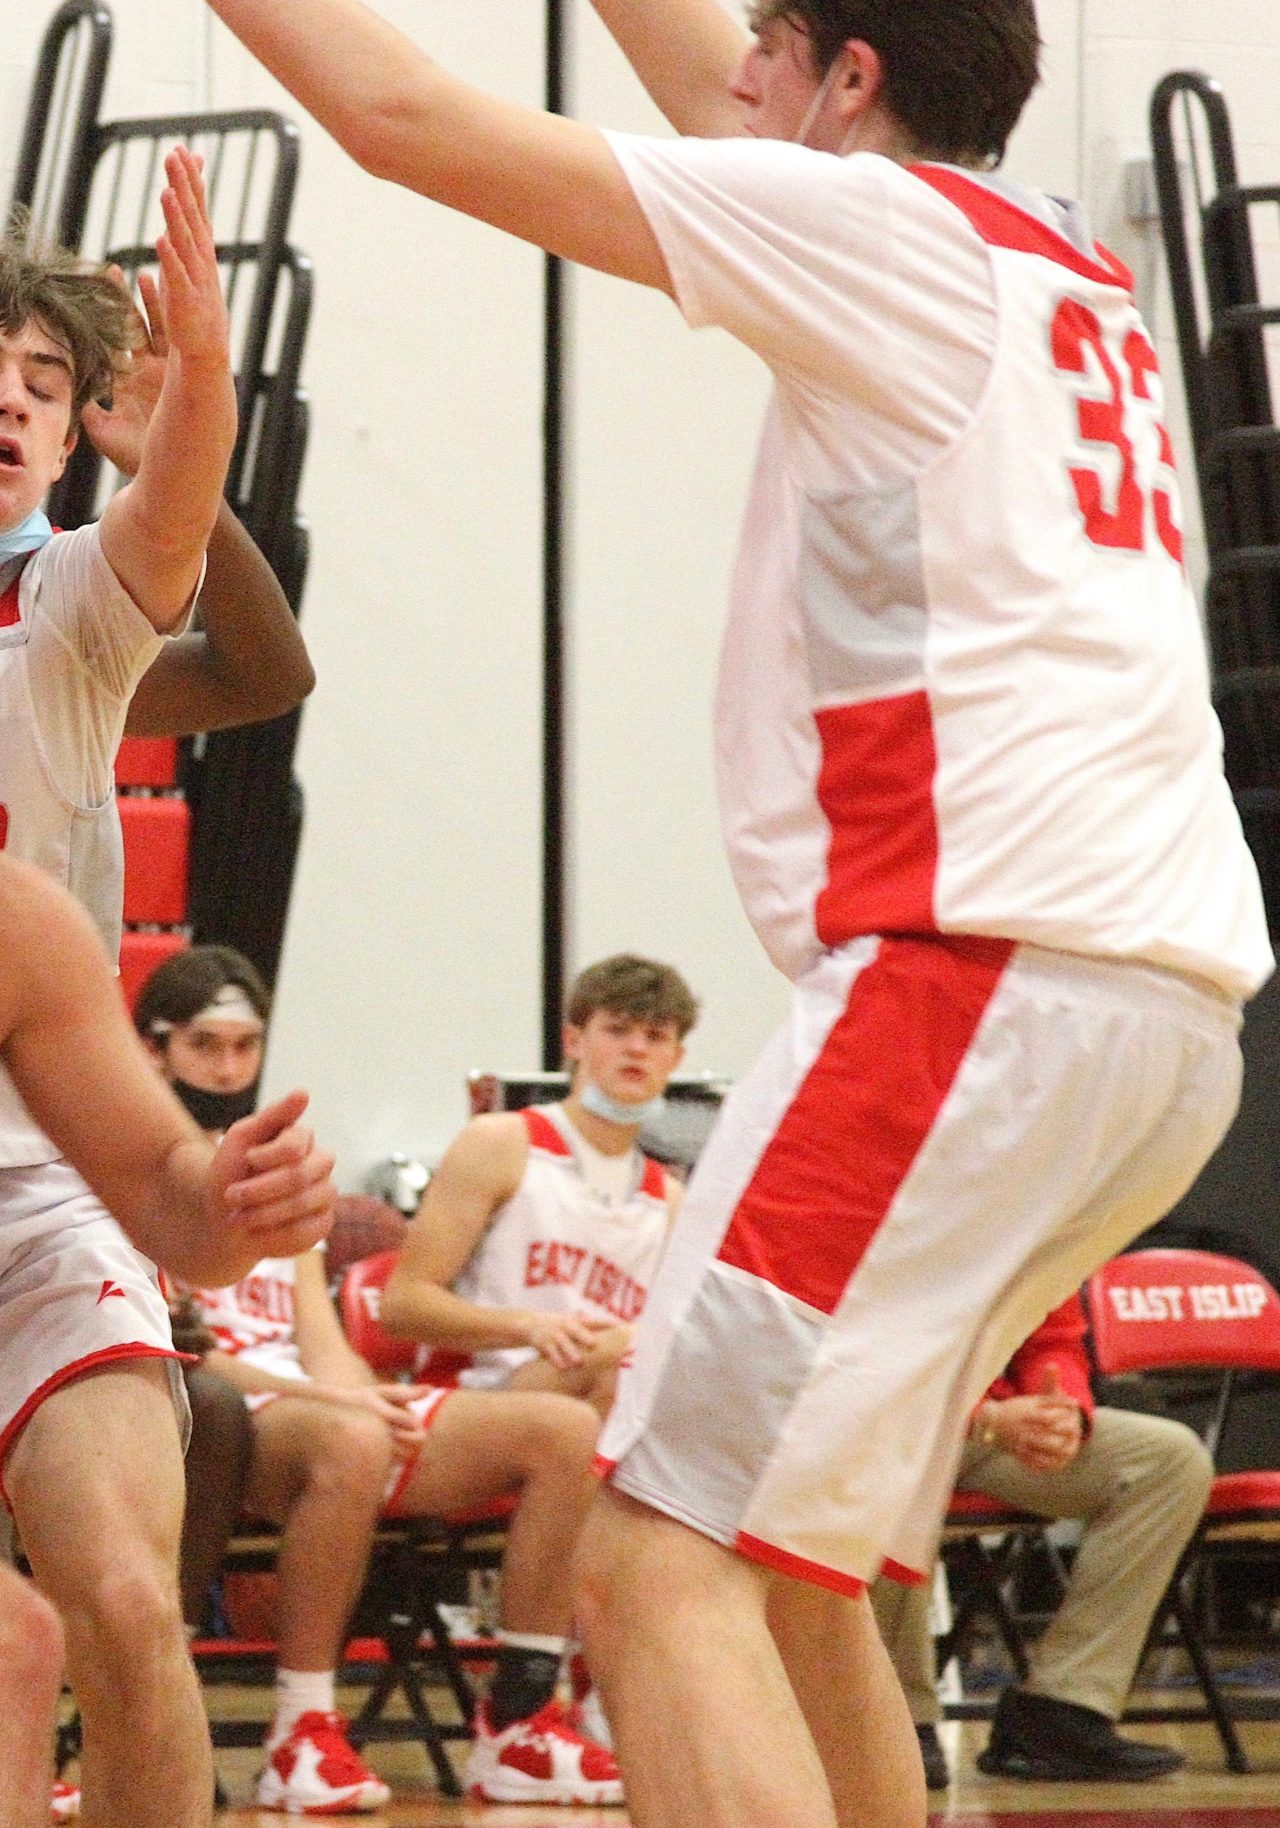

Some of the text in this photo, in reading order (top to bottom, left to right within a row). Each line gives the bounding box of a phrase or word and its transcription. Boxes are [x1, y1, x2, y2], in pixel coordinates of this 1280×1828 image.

[523, 1239, 648, 1323] EAST ISLIP
[1108, 1283, 1269, 1322] EAST ISLIP
